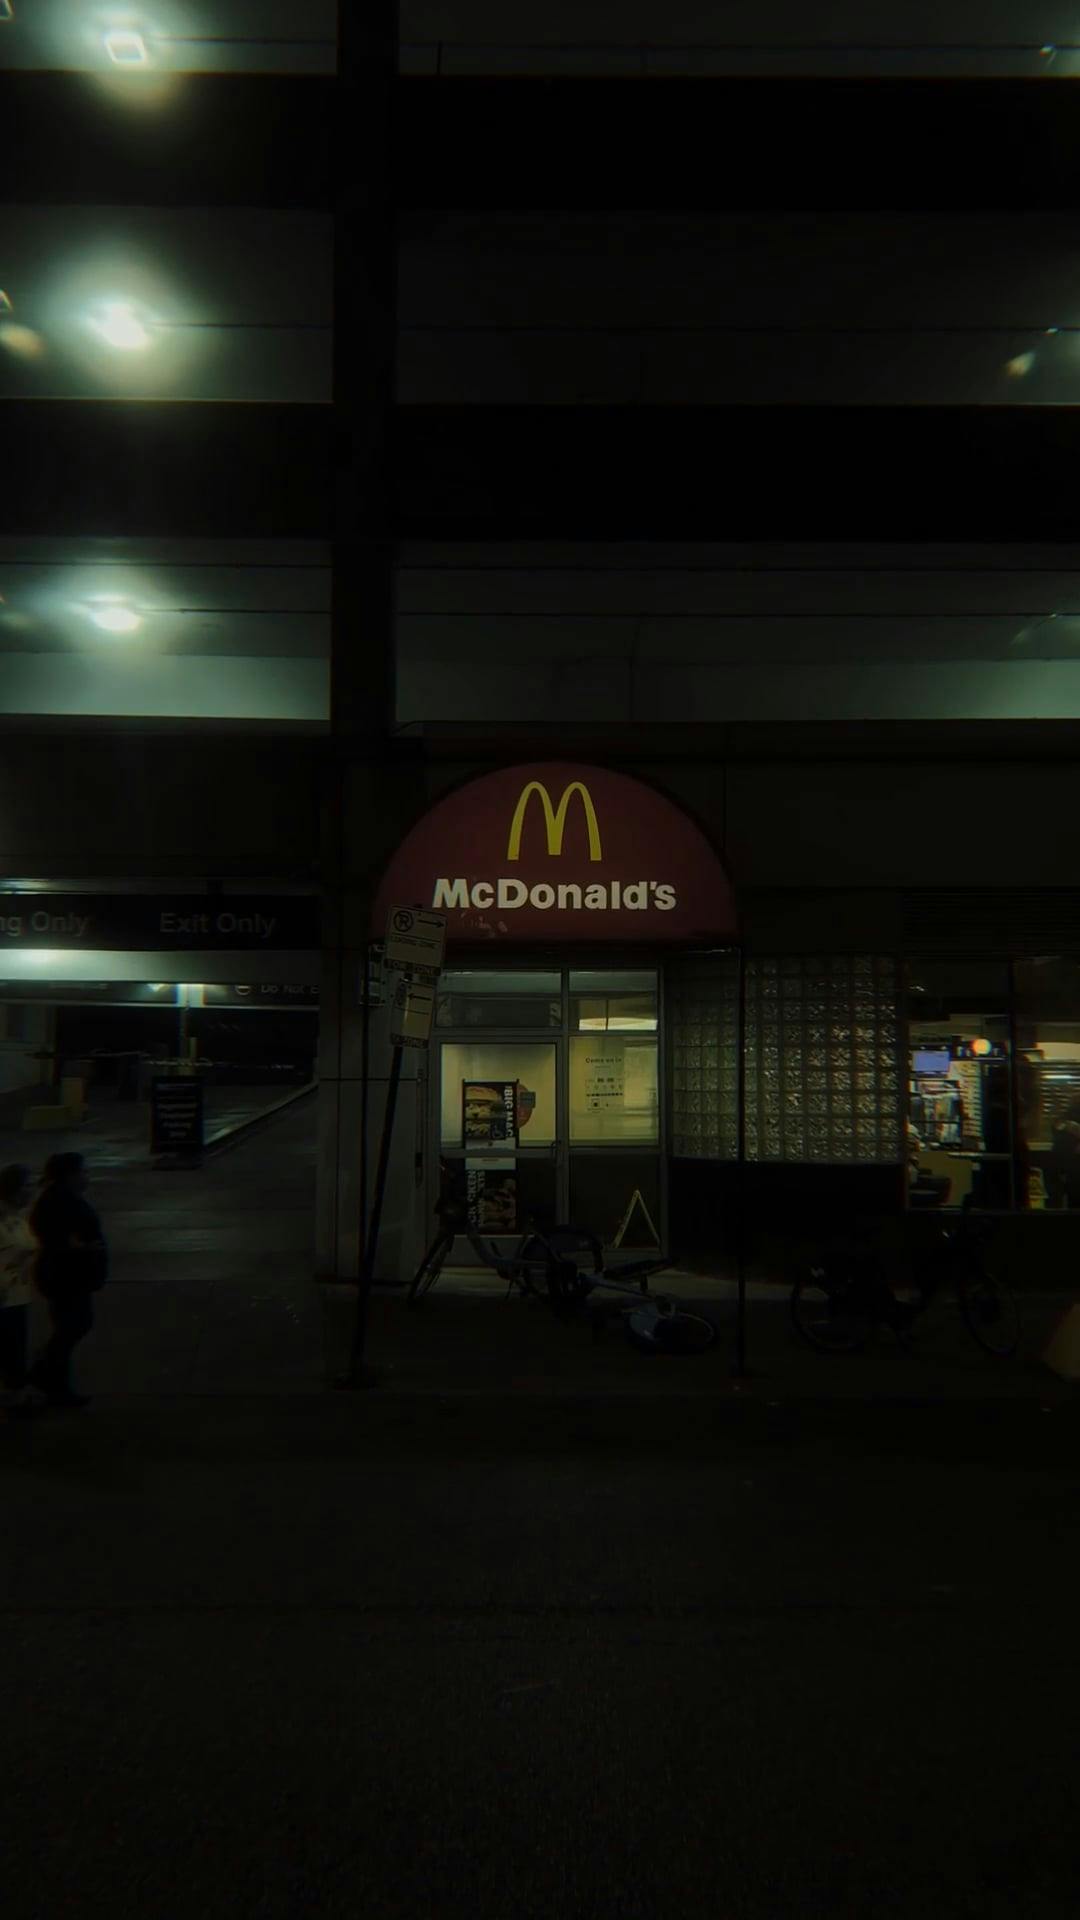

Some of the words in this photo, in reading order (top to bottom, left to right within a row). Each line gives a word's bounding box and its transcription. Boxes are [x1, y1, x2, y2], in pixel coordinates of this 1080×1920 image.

[432, 878, 677, 911] McDonald's
[32, 910, 88, 937] Only
[159, 911, 209, 933] Exit
[216, 911, 277, 938] Only
[503, 1088, 514, 1110] BIG
